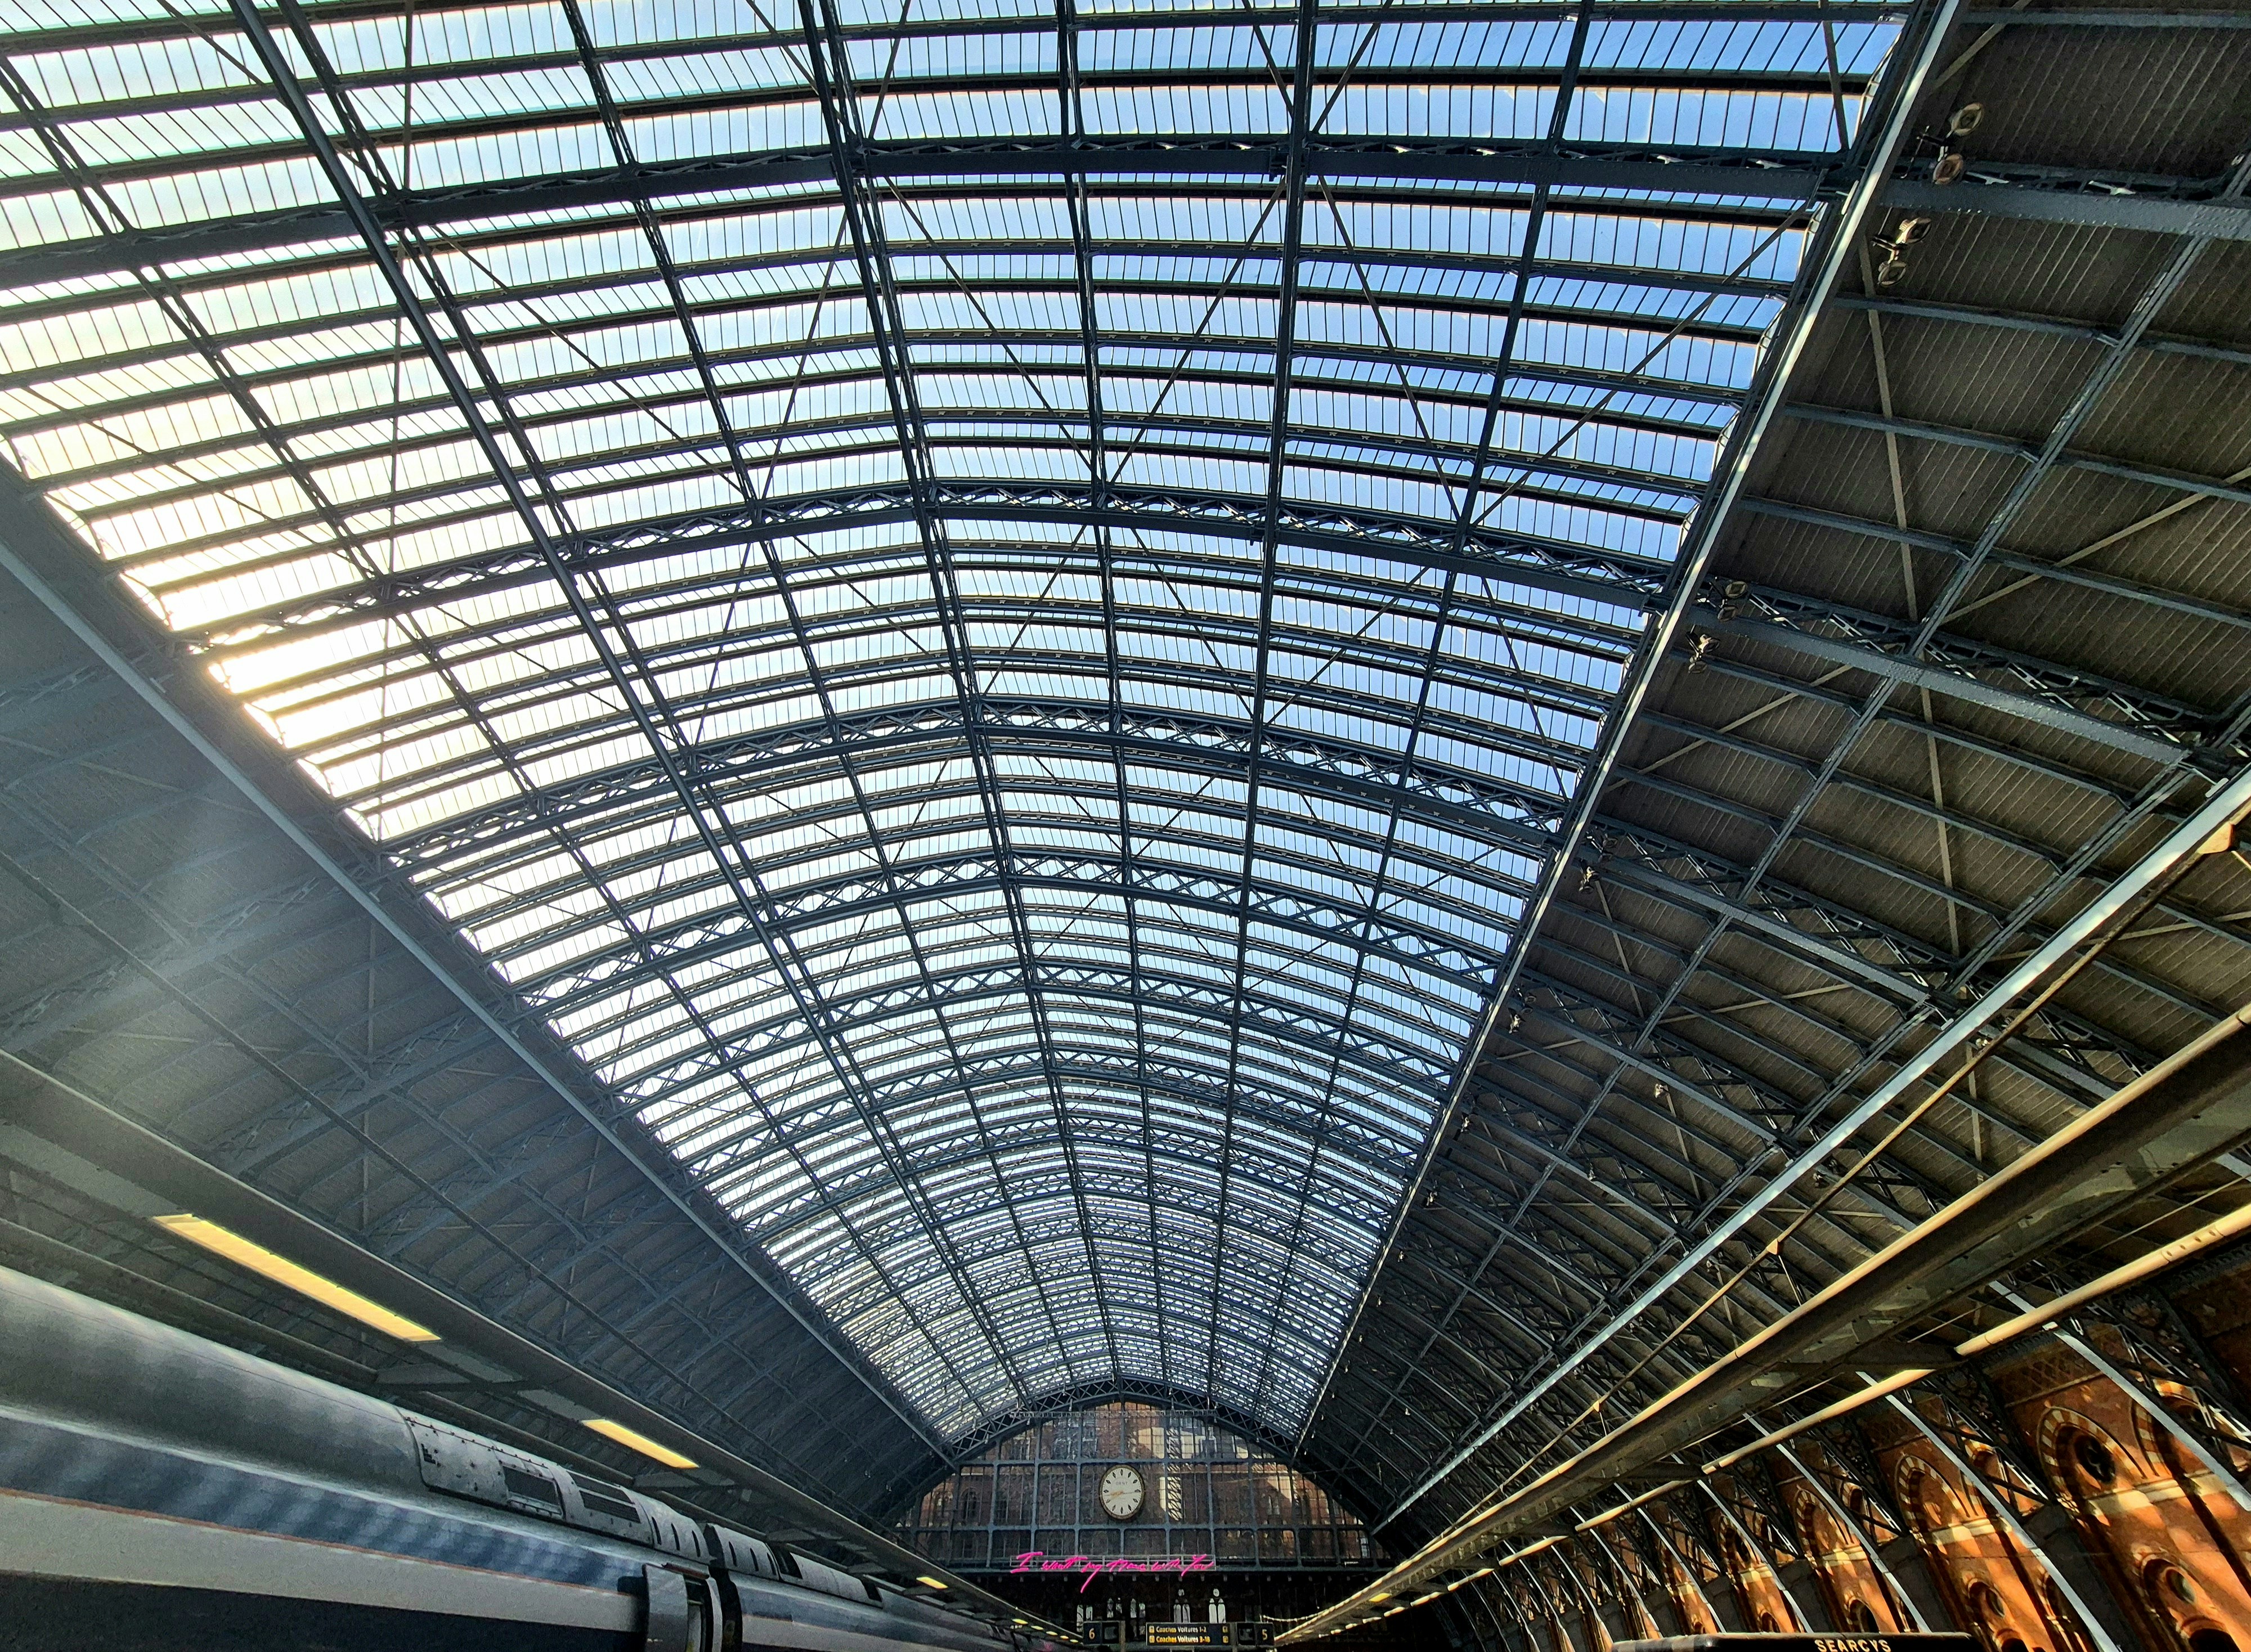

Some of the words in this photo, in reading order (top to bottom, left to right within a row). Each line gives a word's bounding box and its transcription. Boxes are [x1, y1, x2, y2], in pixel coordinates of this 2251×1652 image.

[1010, 1551, 1043, 1573] I
[1042, 1556, 1088, 1570] want
[1075, 1561, 1103, 1593] my
[1106, 1558, 1146, 1572] time
[1151, 1557, 1182, 1572] with
[1181, 1554, 1214, 1576] You
[1089, 1628, 1095, 1640] 6
[1262, 1629, 1267, 1640] 5
[1814, 1639, 1891, 1652] SEARCYS
